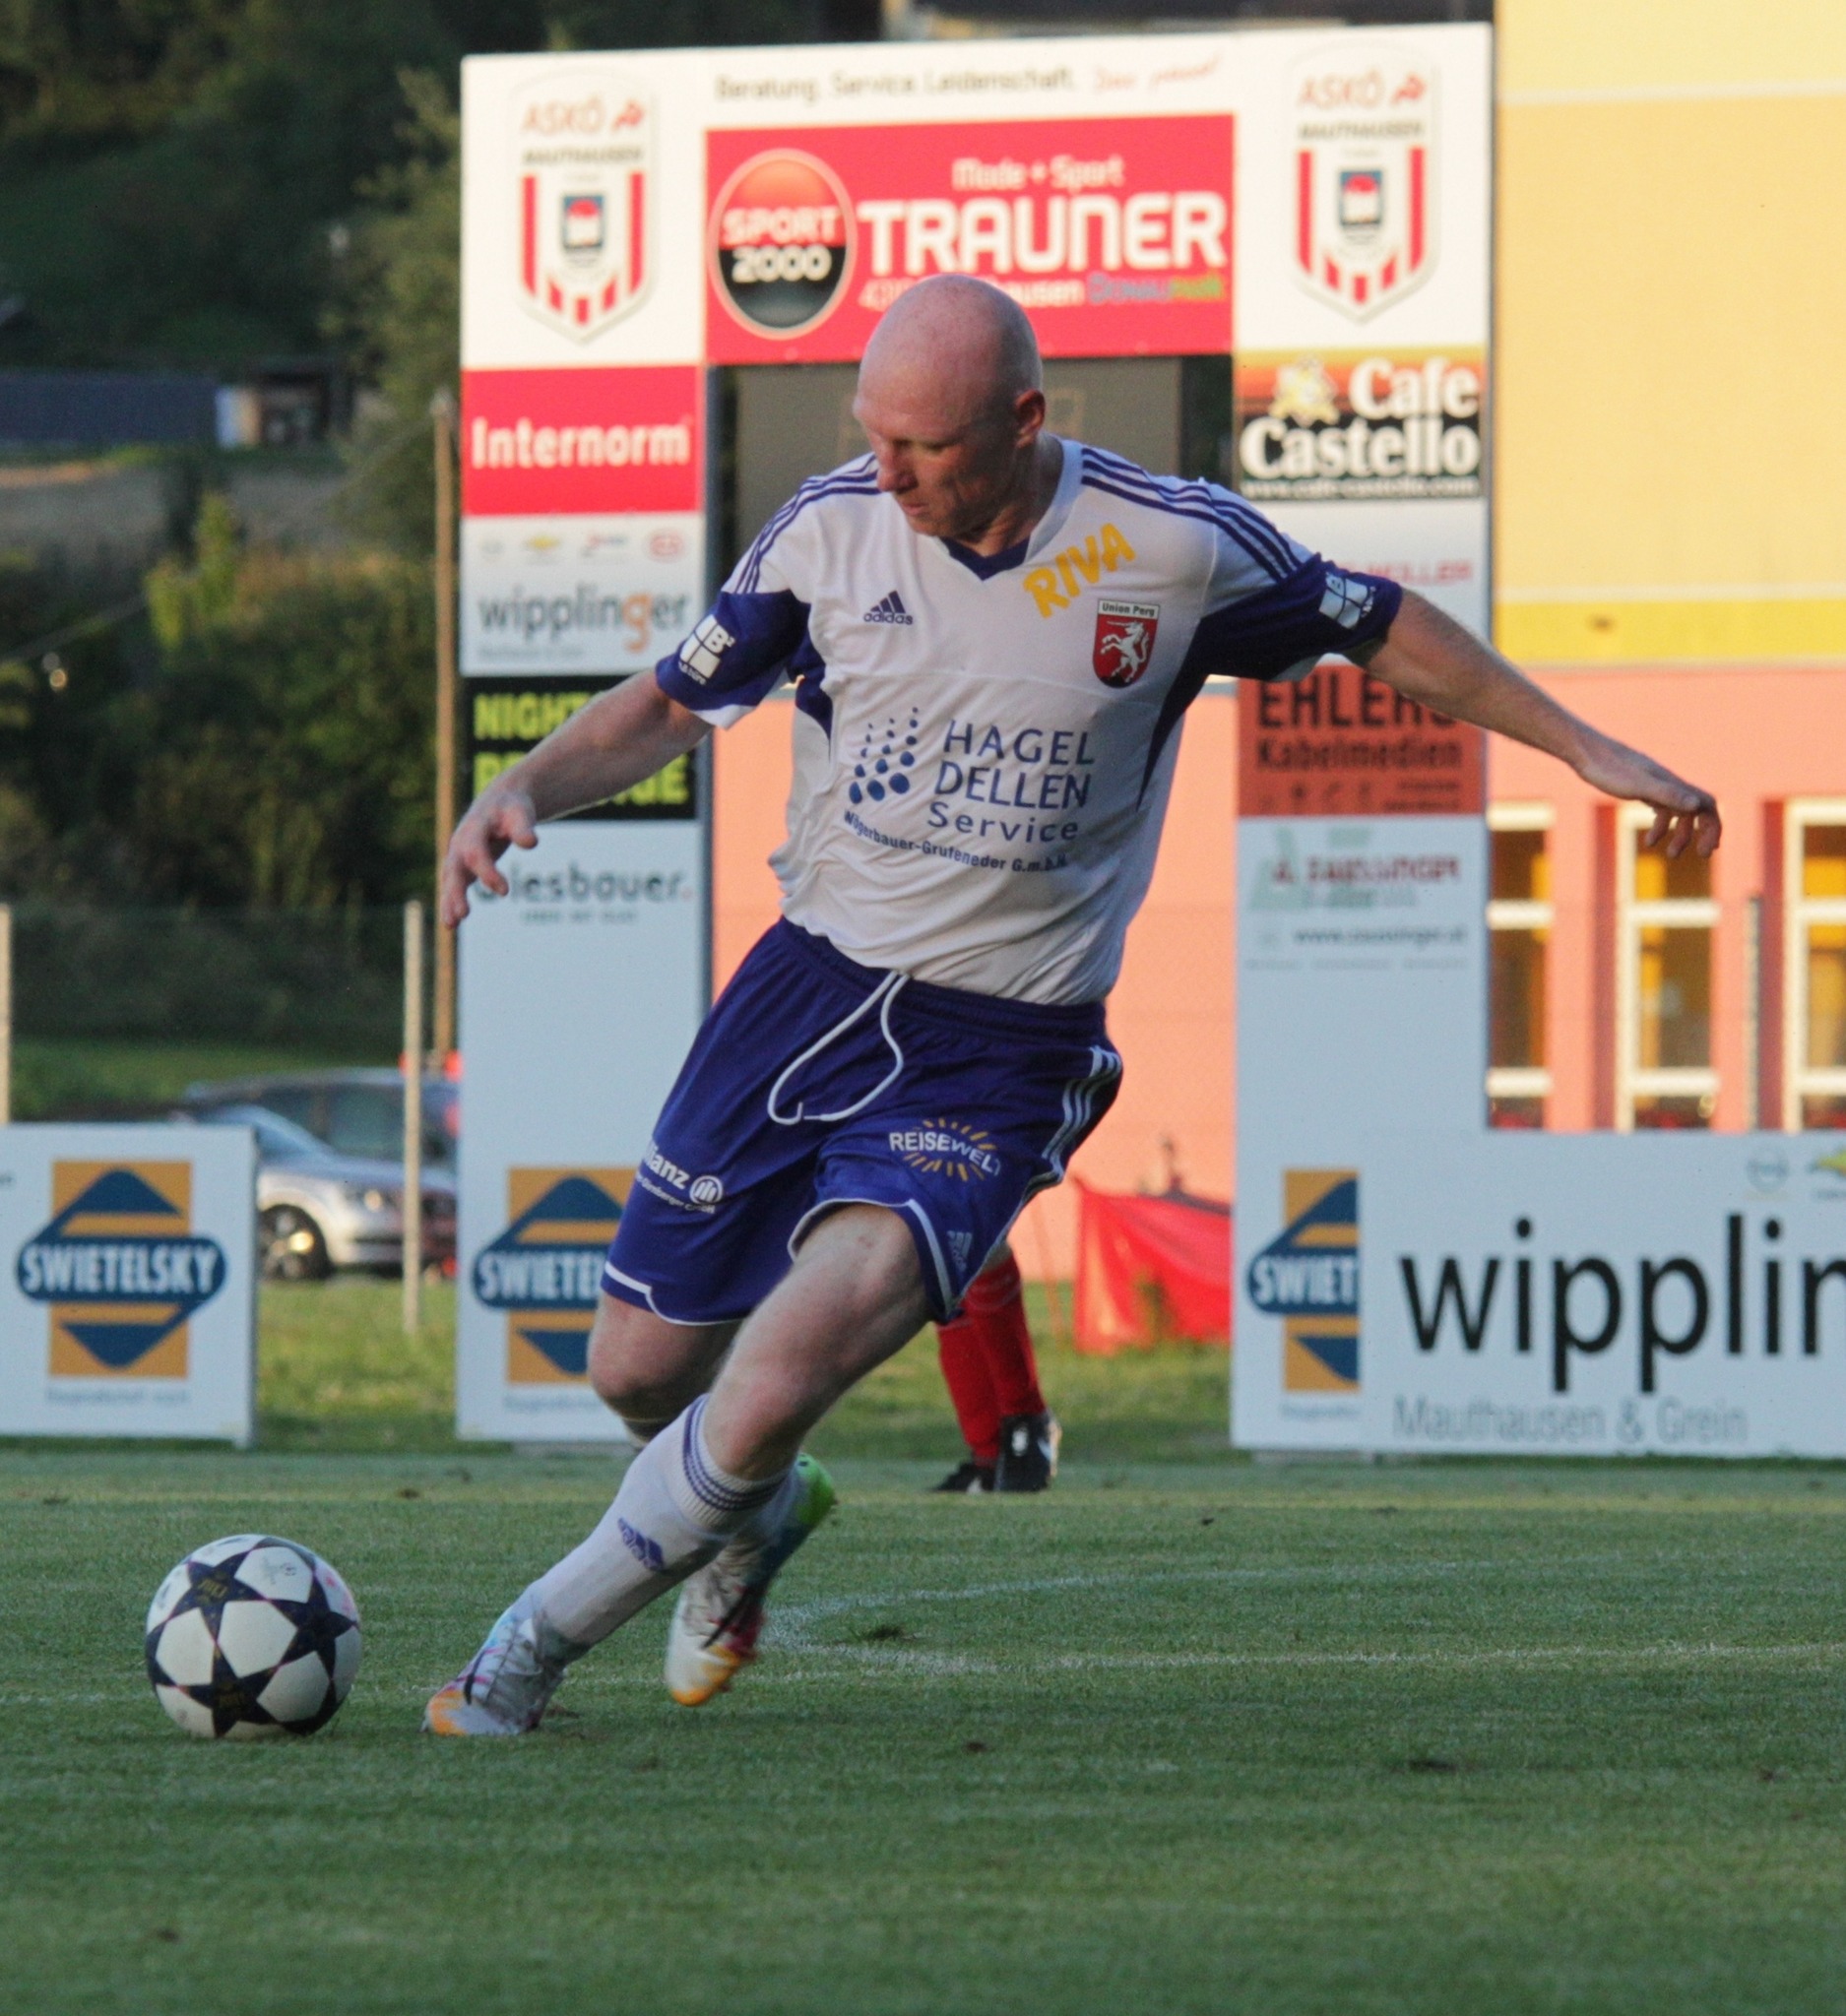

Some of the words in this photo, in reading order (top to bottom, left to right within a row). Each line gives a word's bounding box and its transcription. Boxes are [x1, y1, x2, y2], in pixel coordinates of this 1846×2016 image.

[1050, 154, 1125, 194] Sport
[723, 206, 840, 245] SPORT
[857, 191, 1228, 276] TRAUNER
[732, 245, 832, 283] 2000
[1349, 357, 1478, 419] Cafe
[472, 416, 690, 469] Internorm
[1241, 416, 1480, 479] Castello
[1023, 523, 1135, 619] RIVA
[477, 580, 686, 654] wipplinger
[863, 610, 914, 625] adidas
[1103, 602, 1130, 614] Union
[1133, 605, 1155, 617] Perg
[943, 720, 1095, 765] HAGEL
[1257, 737, 1462, 771] Kabelmedien
[935, 760, 1091, 809] DELLEN
[927, 801, 1079, 843] Service
[22, 1242, 218, 1293] SWIETELSKY
[478, 1251, 605, 1299] SWIETE
[1393, 1394, 1608, 1442] Mauthausen
[1615, 1398, 1646, 1444] &
[1656, 1395, 1749, 1444] Grein
